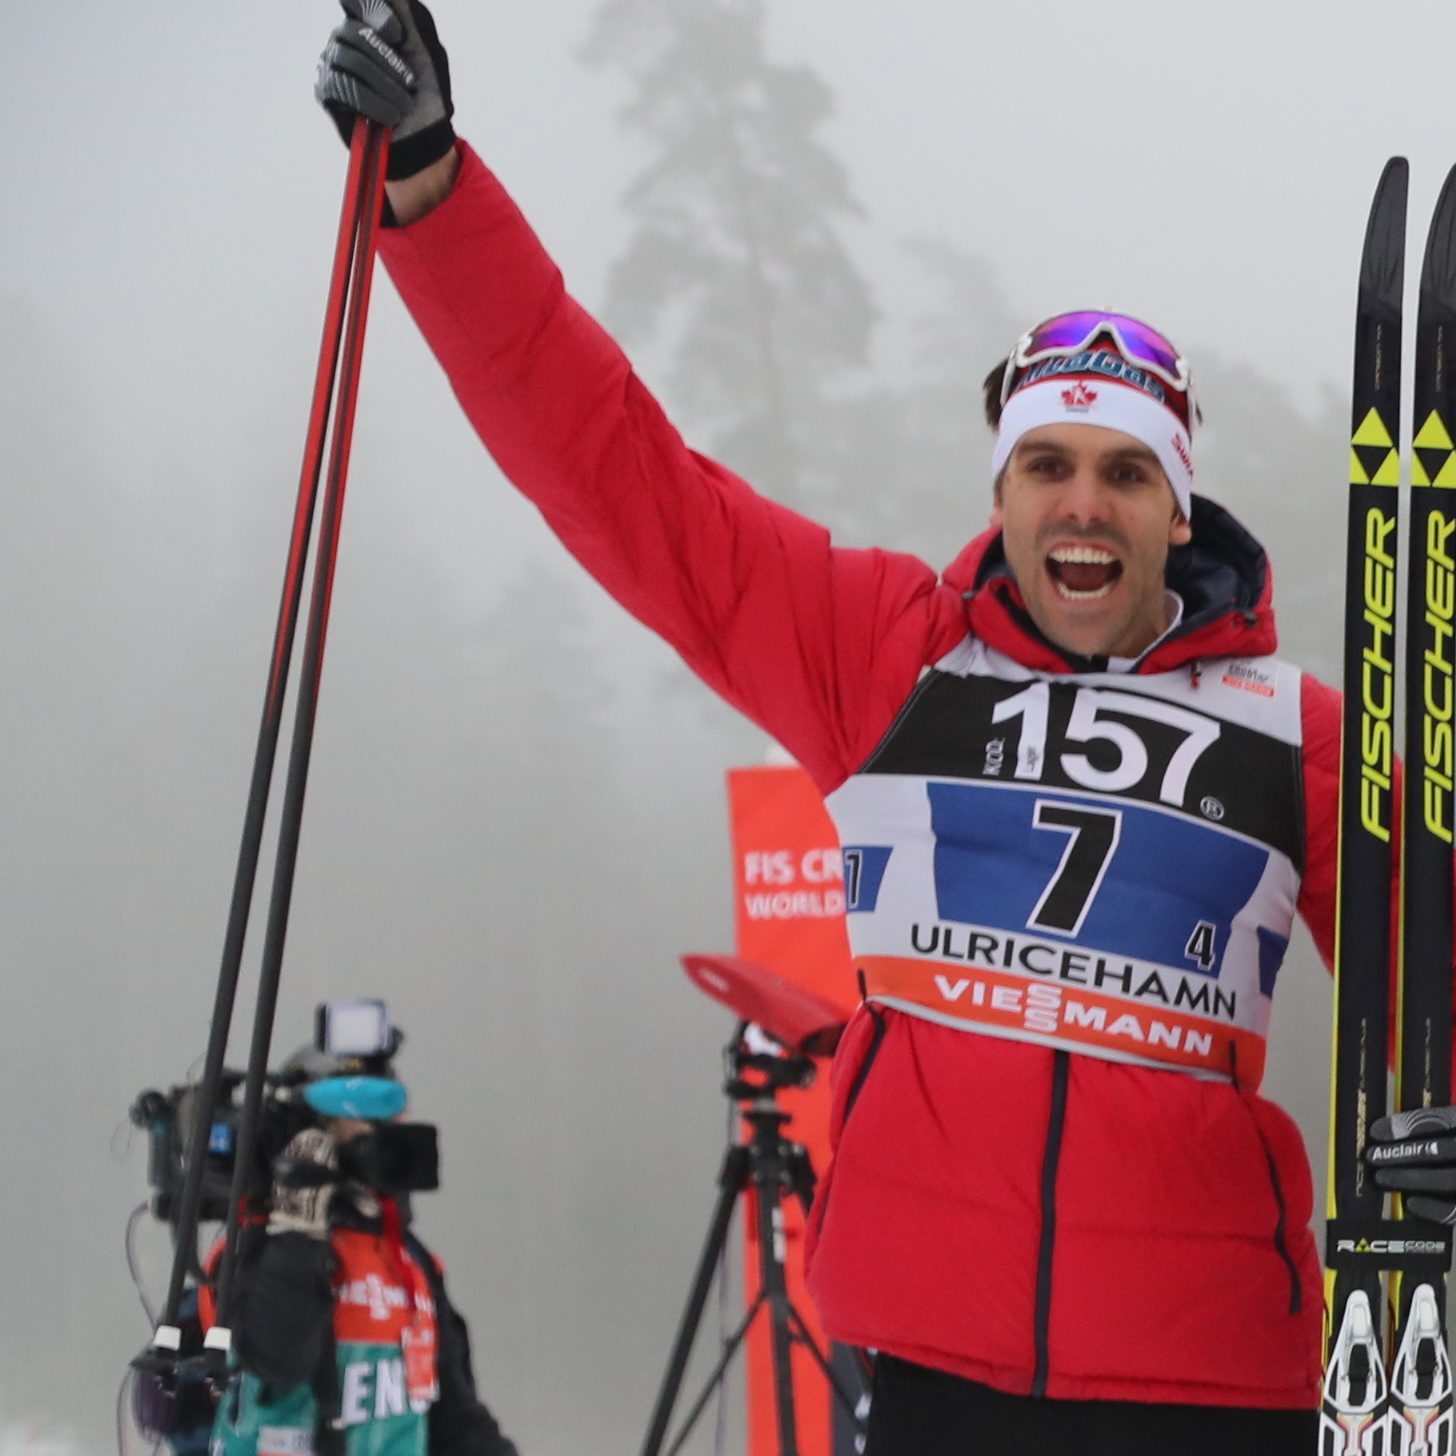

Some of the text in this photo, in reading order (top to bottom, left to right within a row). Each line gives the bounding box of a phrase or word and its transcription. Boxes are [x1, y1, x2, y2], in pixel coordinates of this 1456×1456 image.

[1361, 508, 1395, 843] FISCHER
[1424, 509, 1456, 845] FISCHER
[991, 681, 1222, 808] 157
[745, 892, 845, 920] WORLD
[1025, 803, 1123, 939] 7
[910, 922, 1237, 1021] ULRICEHAMN
[1184, 920, 1218, 972] 4
[933, 975, 1213, 1057] VIESSMANN
[1372, 1142, 1424, 1161] Auclair
